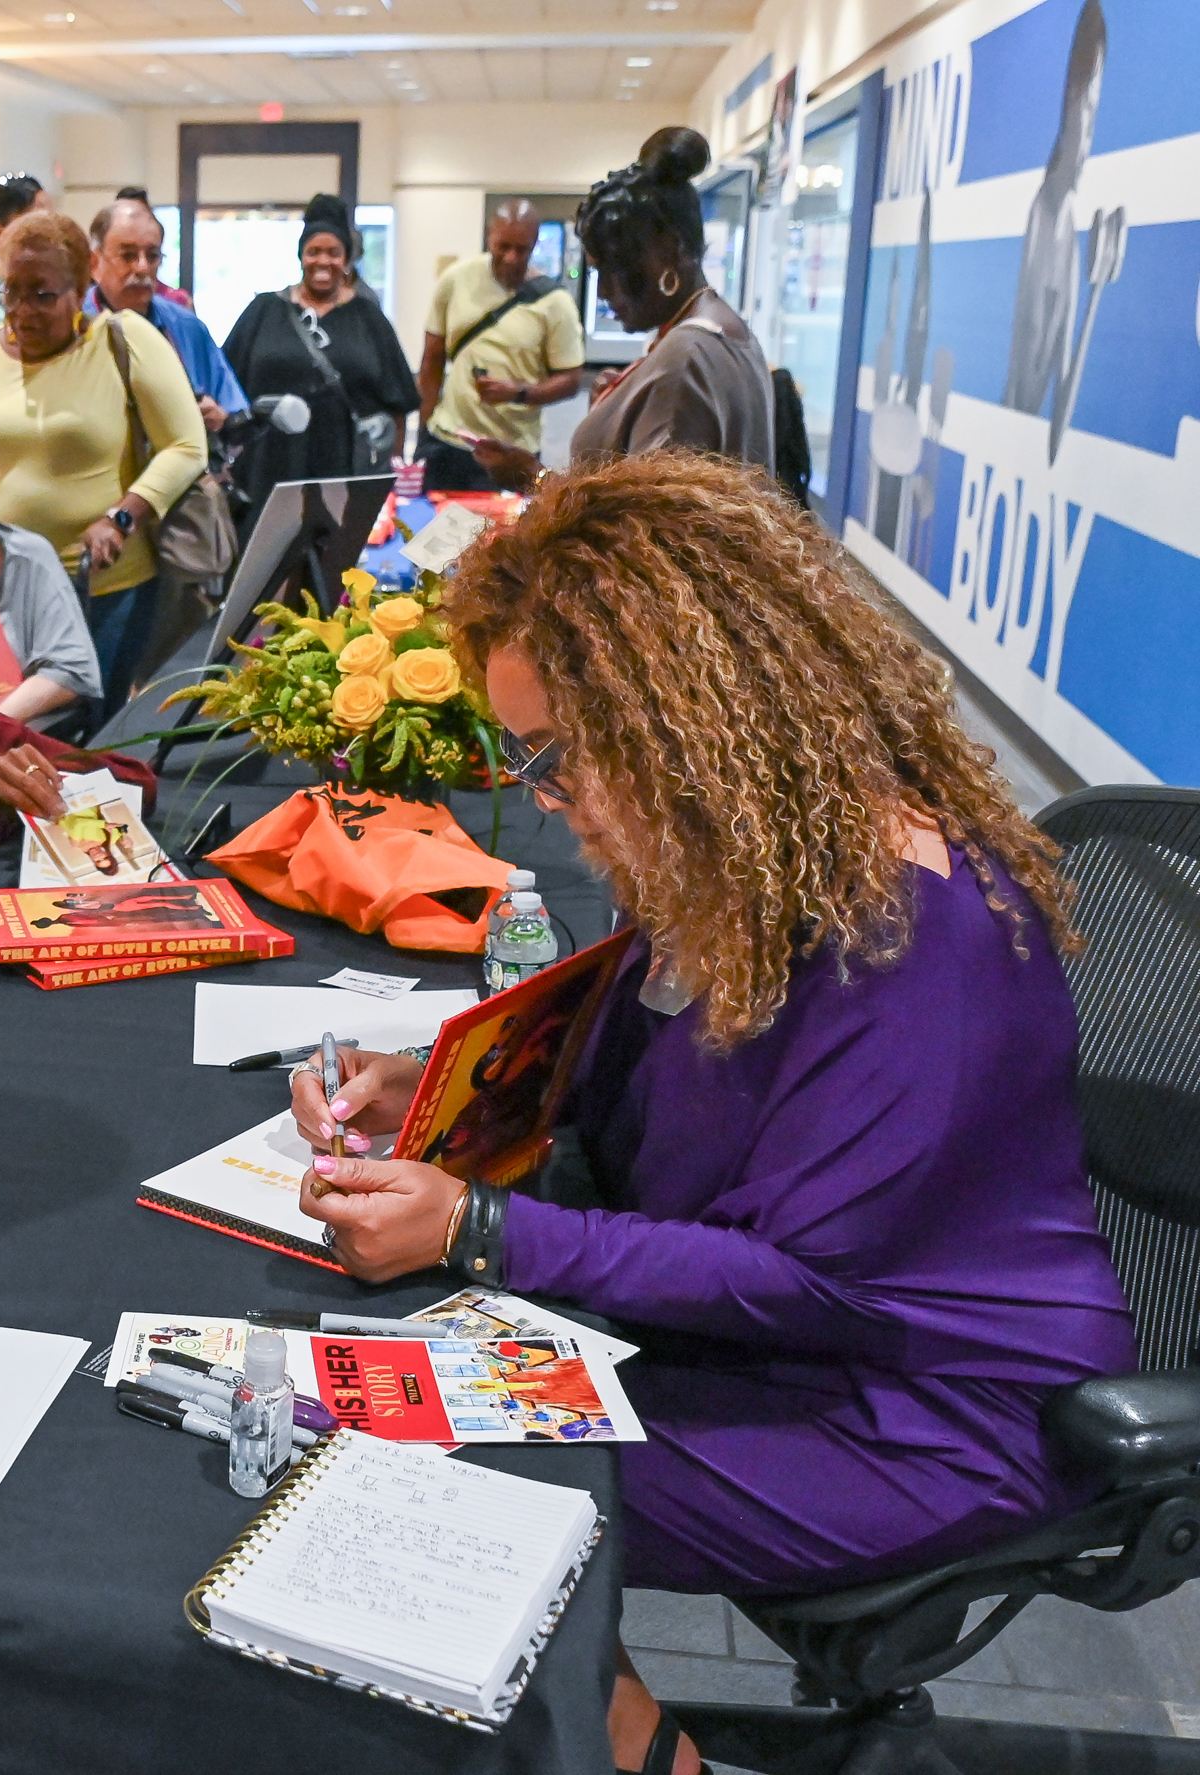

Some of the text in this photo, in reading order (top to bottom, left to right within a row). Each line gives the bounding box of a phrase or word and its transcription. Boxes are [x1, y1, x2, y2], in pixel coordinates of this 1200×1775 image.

[884, 46, 972, 200] MIND
[952, 458, 1095, 694] BODY
[0, 938, 231, 960] THE ART OF RUTH E CARTER
[52, 971, 84, 987] THE
[87, 966, 119, 982] ART
[122, 963, 144, 977] OF
[146, 956, 188, 973] RUTH
[419, 1037, 463, 1133] CARTER
[133, 1344, 143, 1363] HIP-HOP
[202, 1326, 226, 1362] LATINO
[324, 1344, 362, 1388] HER
[362, 1361, 405, 1417] STORY
[334, 1397, 373, 1431] HIS
